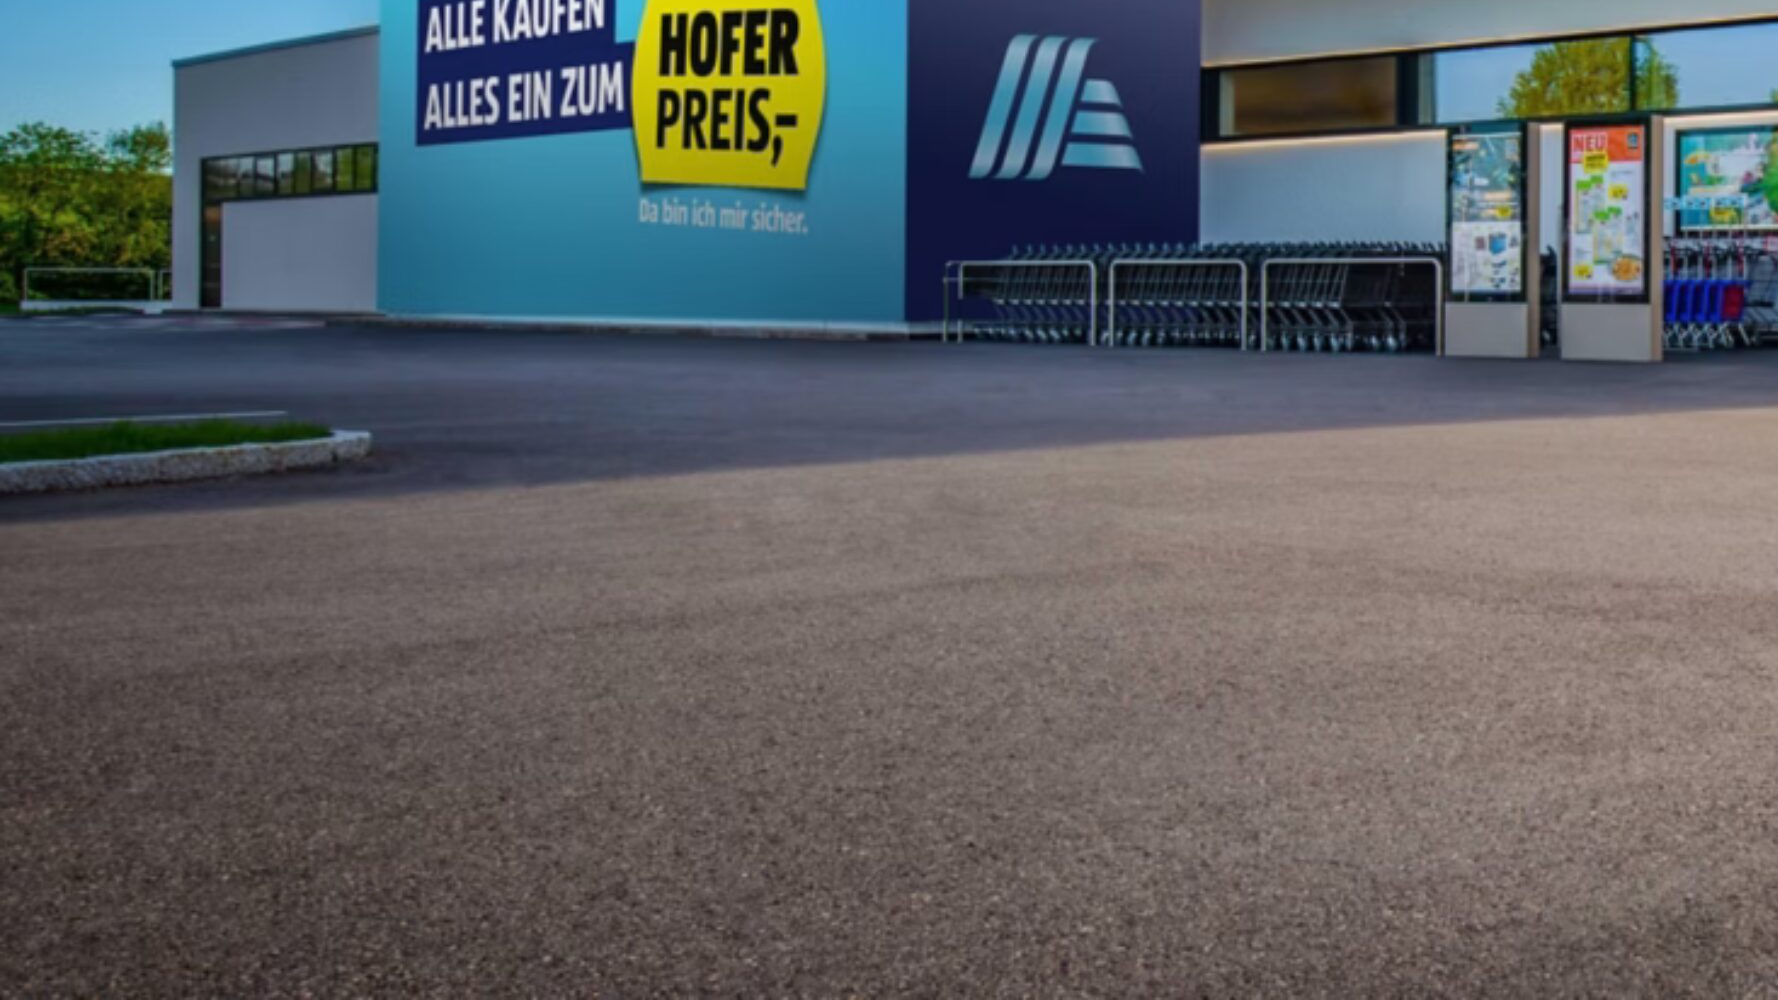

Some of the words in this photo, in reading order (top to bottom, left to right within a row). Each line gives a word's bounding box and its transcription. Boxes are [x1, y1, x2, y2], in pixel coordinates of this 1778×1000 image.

[659, 8, 800, 77] HOFER
[424, 76, 500, 130] ALLES
[507, 69, 552, 122] EIN
[559, 61, 625, 117] ZUM
[656, 88, 798, 167] PREIS,-
[1571, 132, 1608, 156] NEU
[639, 198, 658, 222] Da
[662, 198, 688, 225] bin
[692, 198, 716, 227] ich
[719, 201, 747, 229] mir
[752, 202, 808, 233] sicher.
